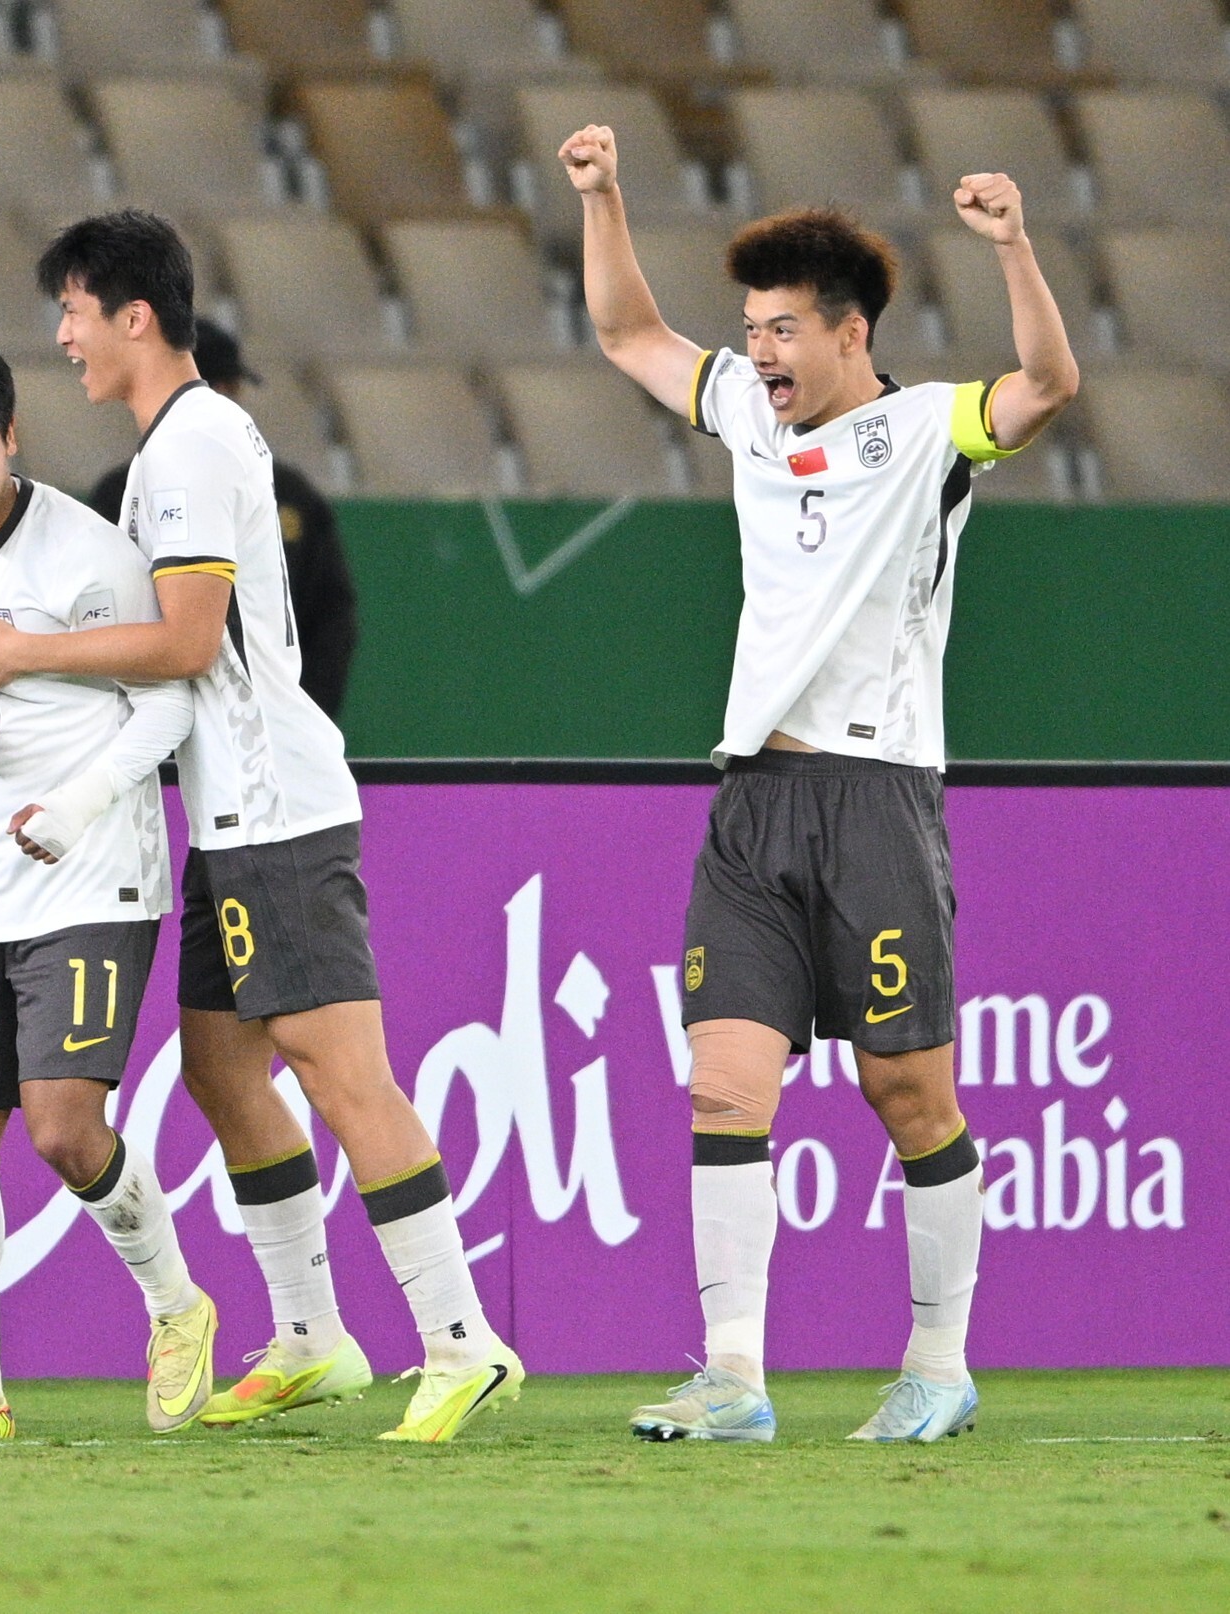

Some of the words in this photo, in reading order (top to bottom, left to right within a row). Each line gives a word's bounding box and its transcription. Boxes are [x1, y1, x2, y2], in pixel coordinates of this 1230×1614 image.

[857, 419, 885, 435] CFA
[160, 507, 183, 522] AFC
[797, 490, 827, 553] 5
[82, 607, 110, 622] AFC
[871, 929, 907, 996] 5
[68, 958, 117, 1029] 11
